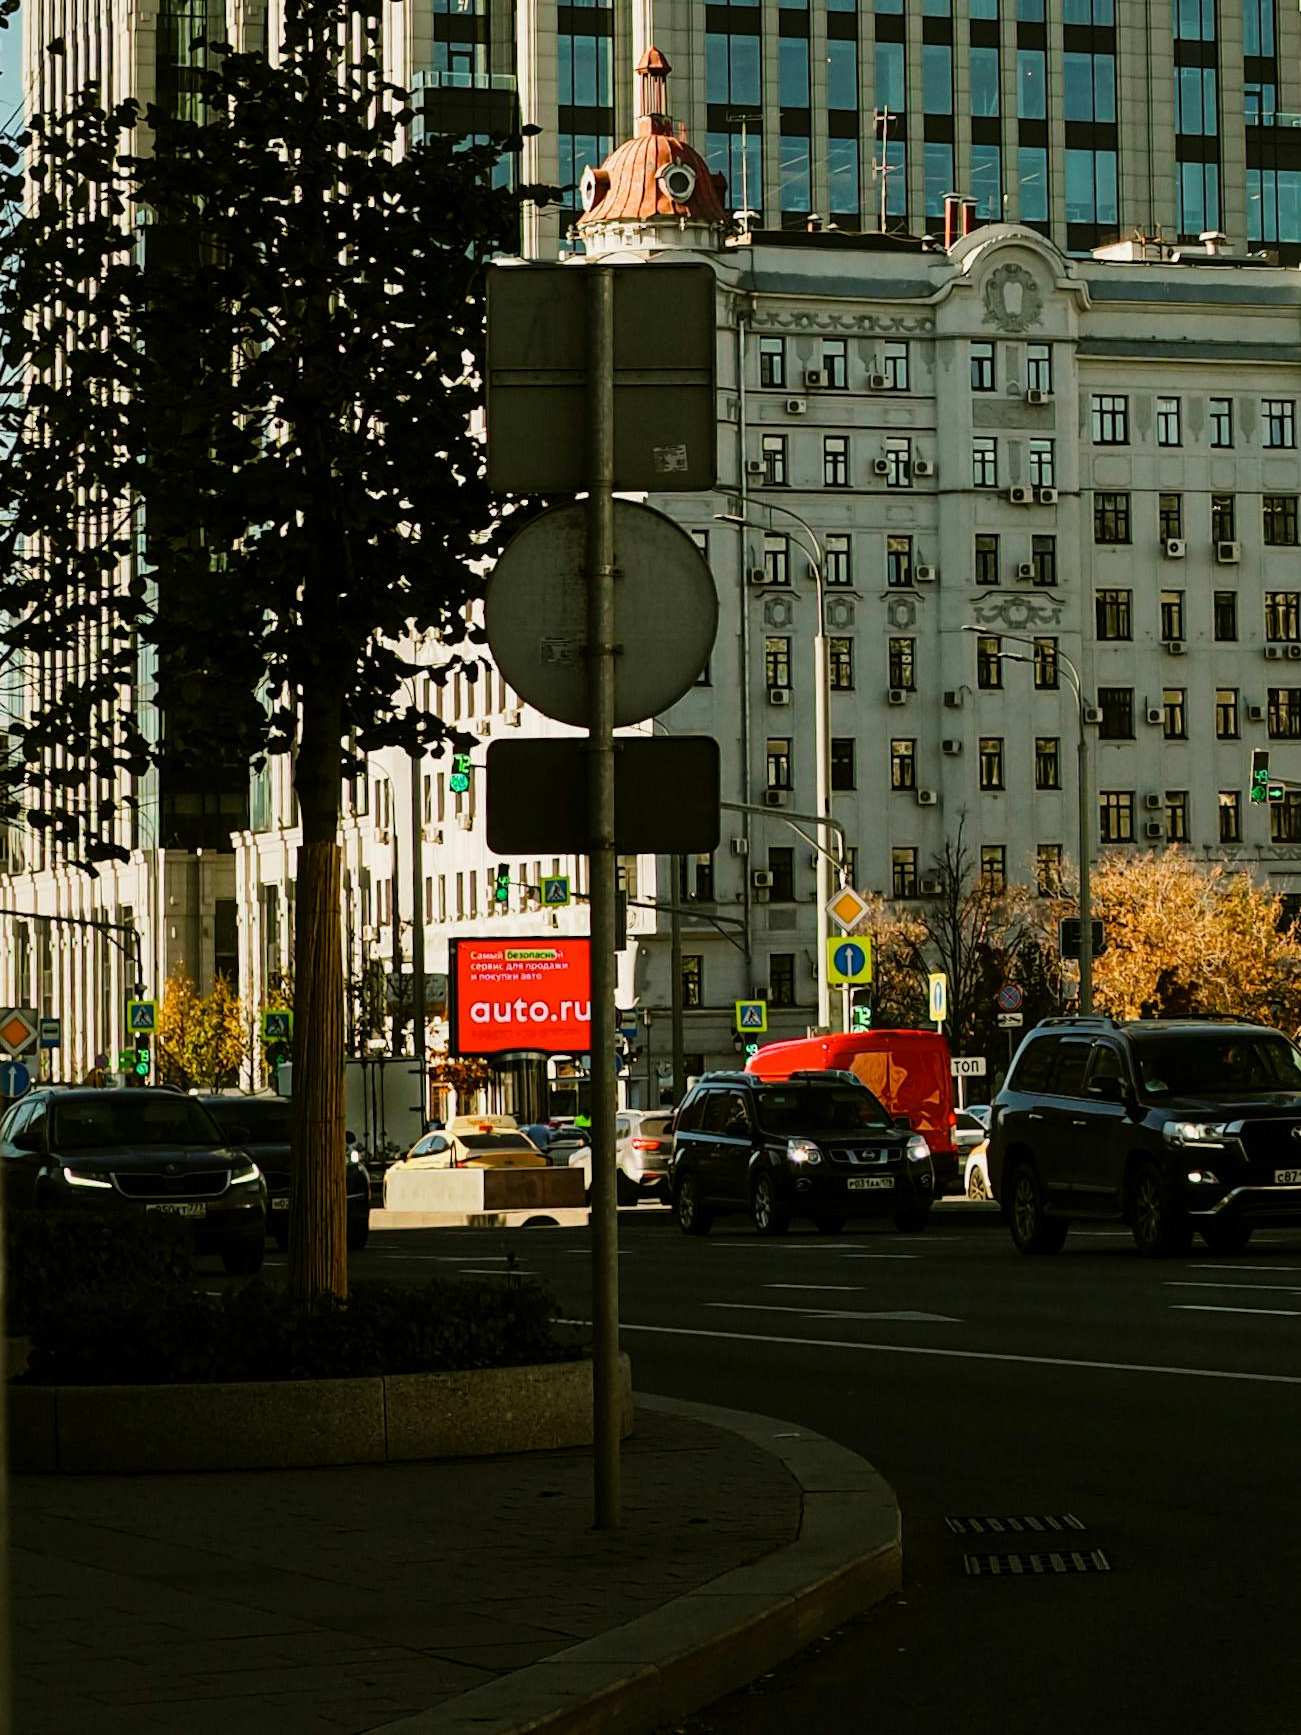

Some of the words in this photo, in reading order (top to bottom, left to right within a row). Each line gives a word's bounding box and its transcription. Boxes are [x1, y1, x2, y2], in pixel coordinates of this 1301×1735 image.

[455, 754, 471, 773] 72
[470, 950, 503, 960] Самый
[470, 963, 504, 971] сервис
[506, 963, 524, 971] для
[525, 962, 568, 971] продажи
[479, 973, 519, 982] покупки
[470, 997, 591, 1024] auto.ru
[954, 1060, 979, 1073] ТОП
